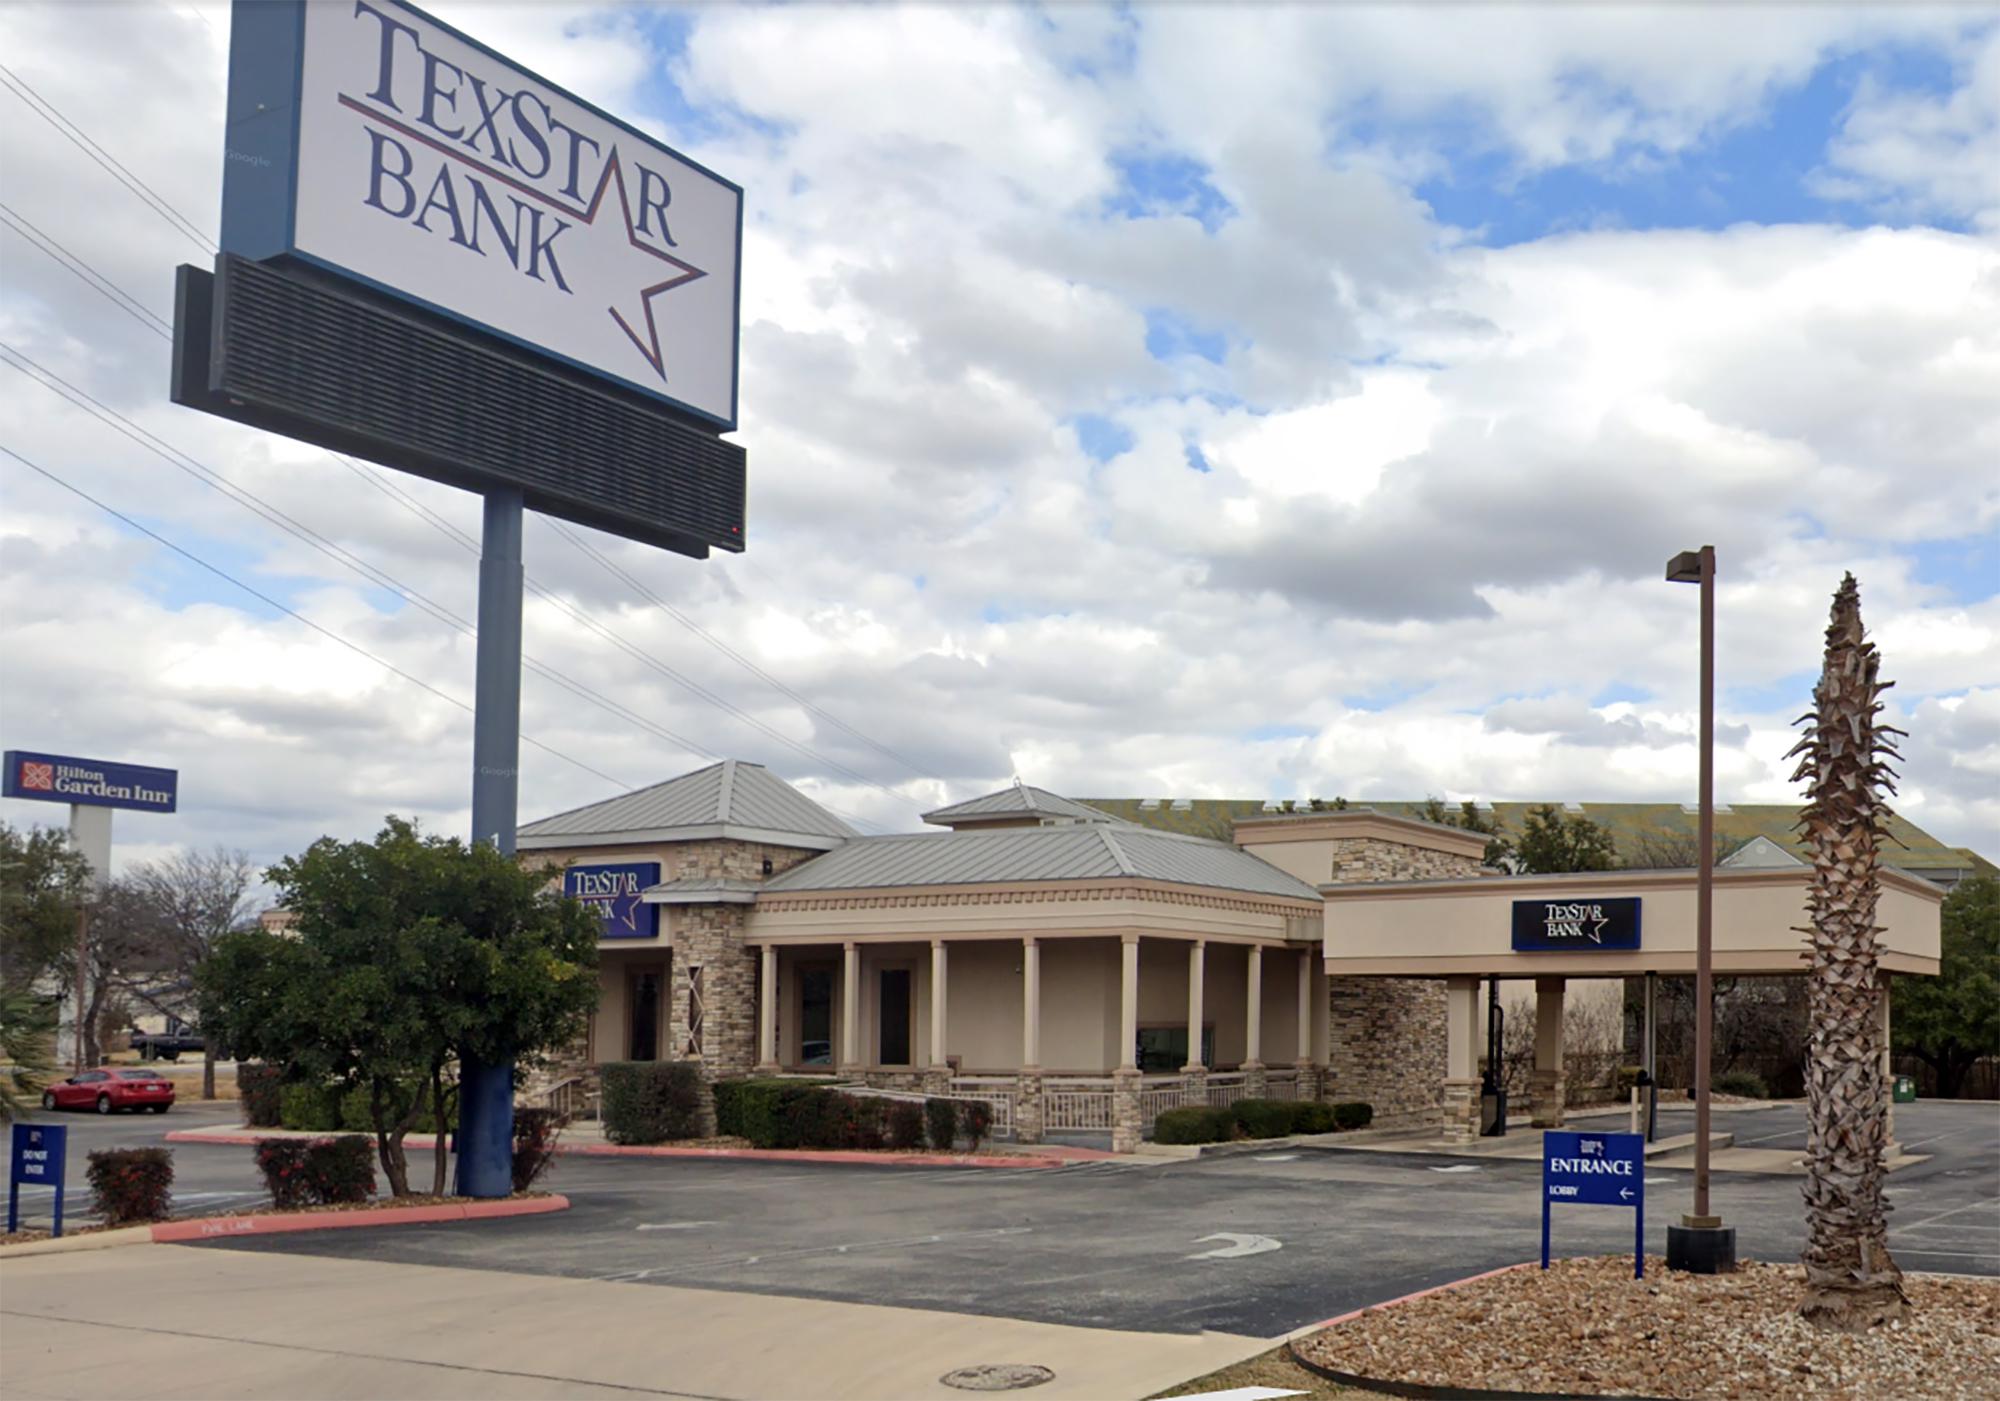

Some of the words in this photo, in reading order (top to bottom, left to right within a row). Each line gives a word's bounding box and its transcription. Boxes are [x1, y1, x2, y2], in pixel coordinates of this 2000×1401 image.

[363, 125, 574, 295] BANK
[56, 765, 105, 781] Hilton
[55, 777, 131, 799] Garden
[134, 785, 170, 804] Inn
[577, 899, 615, 919] NK
[1547, 922, 1583, 937] BANK
[1550, 1158, 1633, 1176] ENTRANCE
[1549, 1185, 1579, 1196] LOBBY
